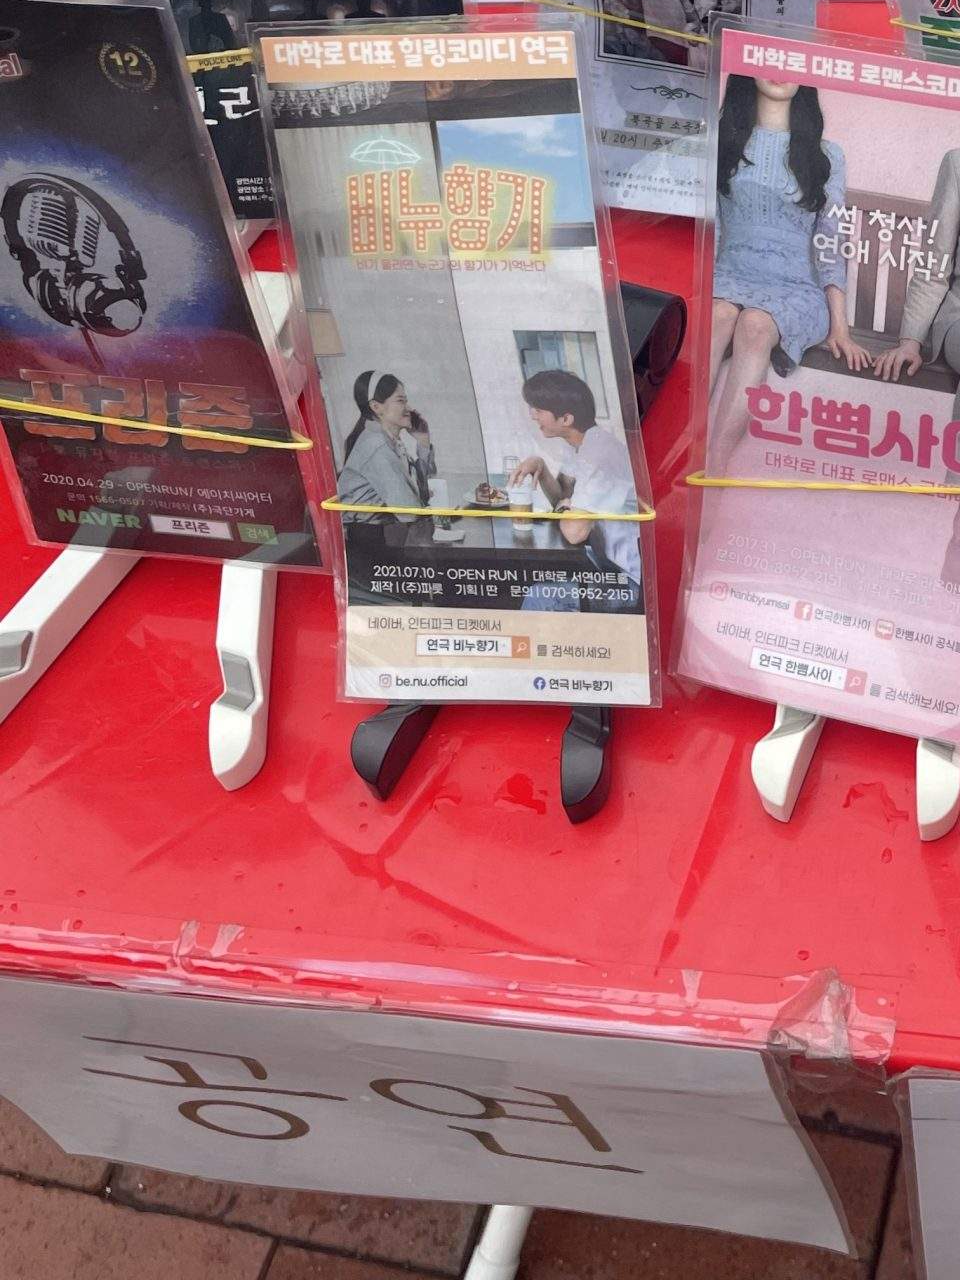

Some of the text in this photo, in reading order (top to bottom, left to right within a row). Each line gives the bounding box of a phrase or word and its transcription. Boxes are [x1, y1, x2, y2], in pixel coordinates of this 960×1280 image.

[273, 36, 569, 68] 대학로 대표 힐링코미디 연극
[742, 44, 807, 73] 대학로
[812, 54, 855, 81] 대표
[347, 164, 546, 255] 비누향기
[827, 203, 940, 247] 썸 청산!
[812, 232, 950, 282] 연애 시작!
[19, 368, 254, 454] 프리즌
[765, 452, 815, 475] 대학로
[822, 462, 855, 483] 대표
[57, 508, 142, 529] NAVER
[172, 519, 271, 540] 프리즌 검색
[374, 565, 629, 585] 2021.07.10 OPEN RUN 대학로 서연아트홀
[370, 581, 393, 593] 제작
[455, 583, 478, 596] 기획
[510, 585, 533, 598] 문의
[542, 586, 636, 601] 070-8952-2151
[368, 616, 502, 632] 네이버, 인터파크 티켓에서
[895, 627, 933, 645] 한뼘사이
[427, 637, 450, 652] 연극
[453, 638, 499, 653] 비누향기
[537, 644, 548, 657] 를
[755, 630, 800, 652] 인터파크
[802, 641, 849, 663] 티켓에서
[395, 674, 468, 688] be.nu.official
[759, 653, 781, 670] 연극
[785, 659, 832, 682] 한뼘사이
[549, 678, 613, 693] 연극 비누향기
[82, 1035, 645, 1175] 공연
